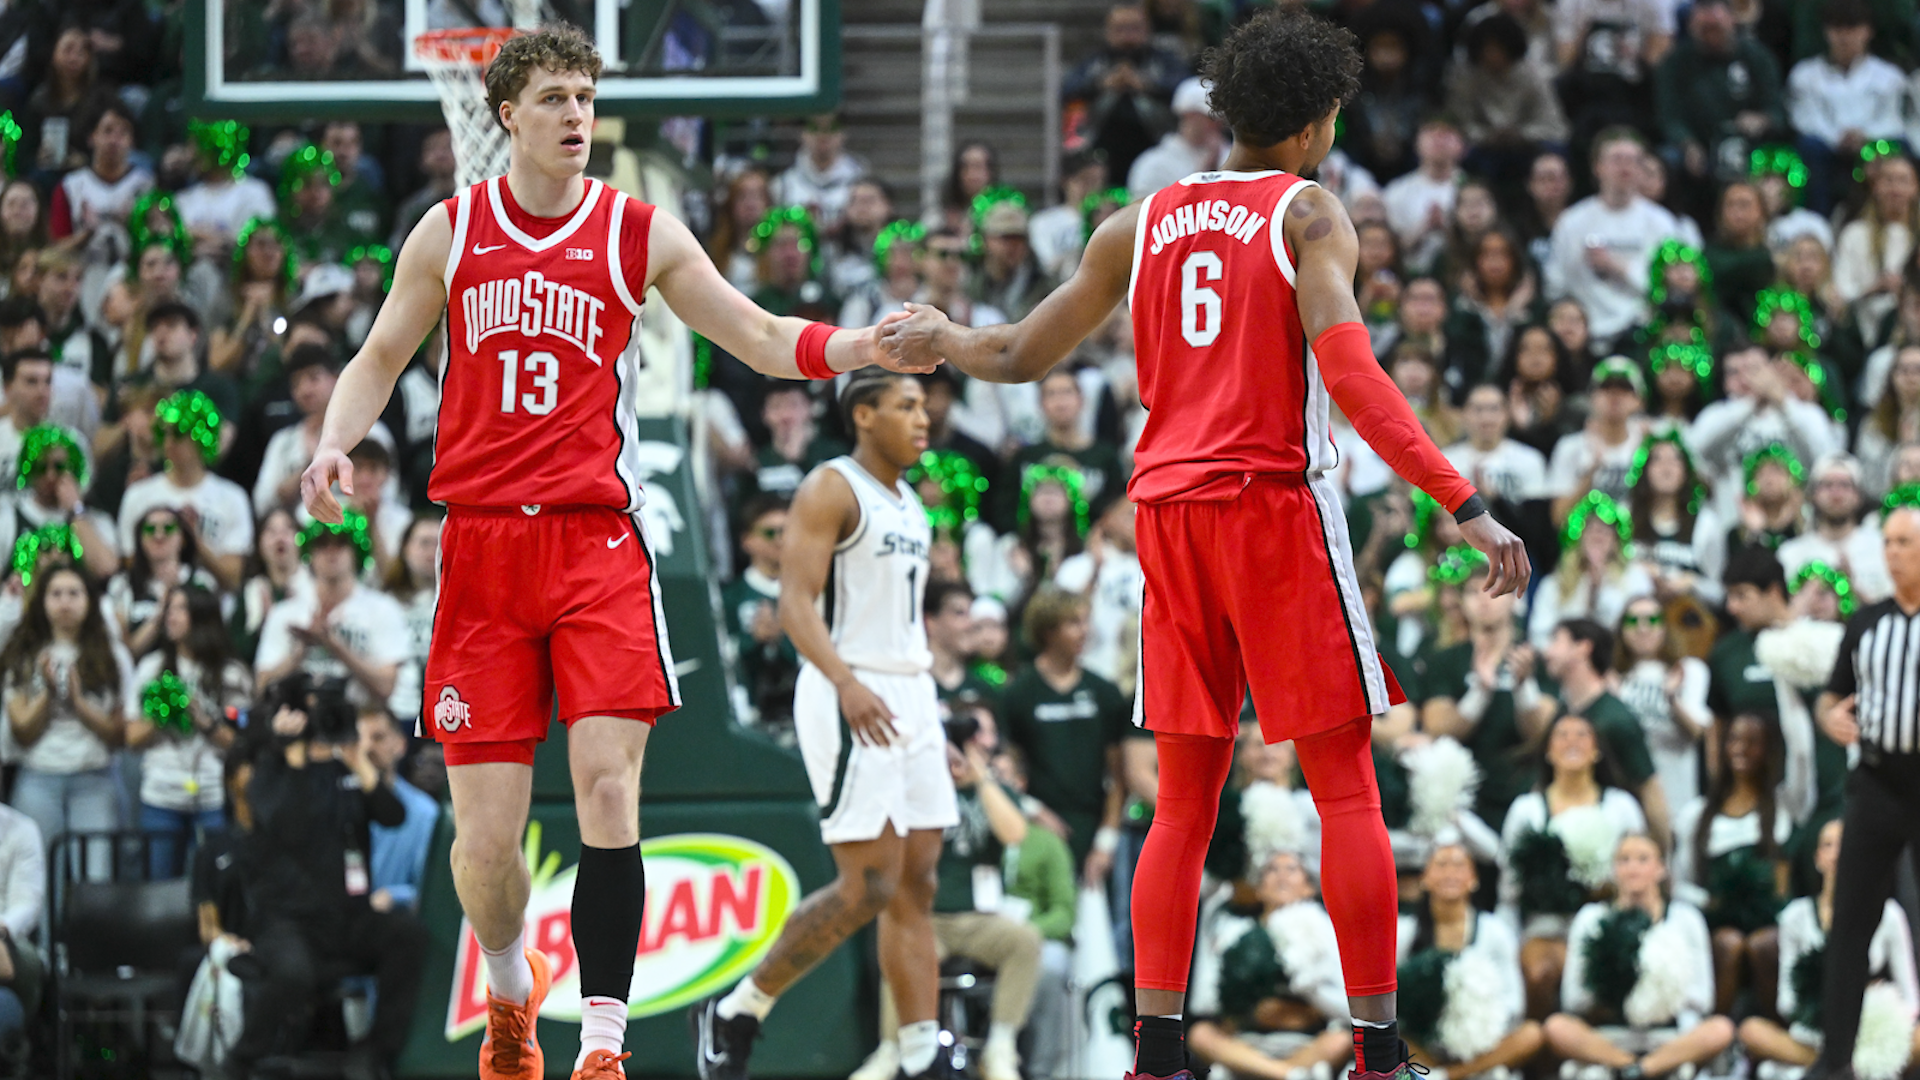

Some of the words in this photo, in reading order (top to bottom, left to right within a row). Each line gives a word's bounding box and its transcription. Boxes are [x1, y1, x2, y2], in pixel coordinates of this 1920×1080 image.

[1150, 199, 1267, 256] JOHNSON
[1181, 250, 1223, 347] 6
[498, 349, 560, 416] 13
[907, 565, 916, 622] 1
[456, 867, 760, 1023] LBAN
